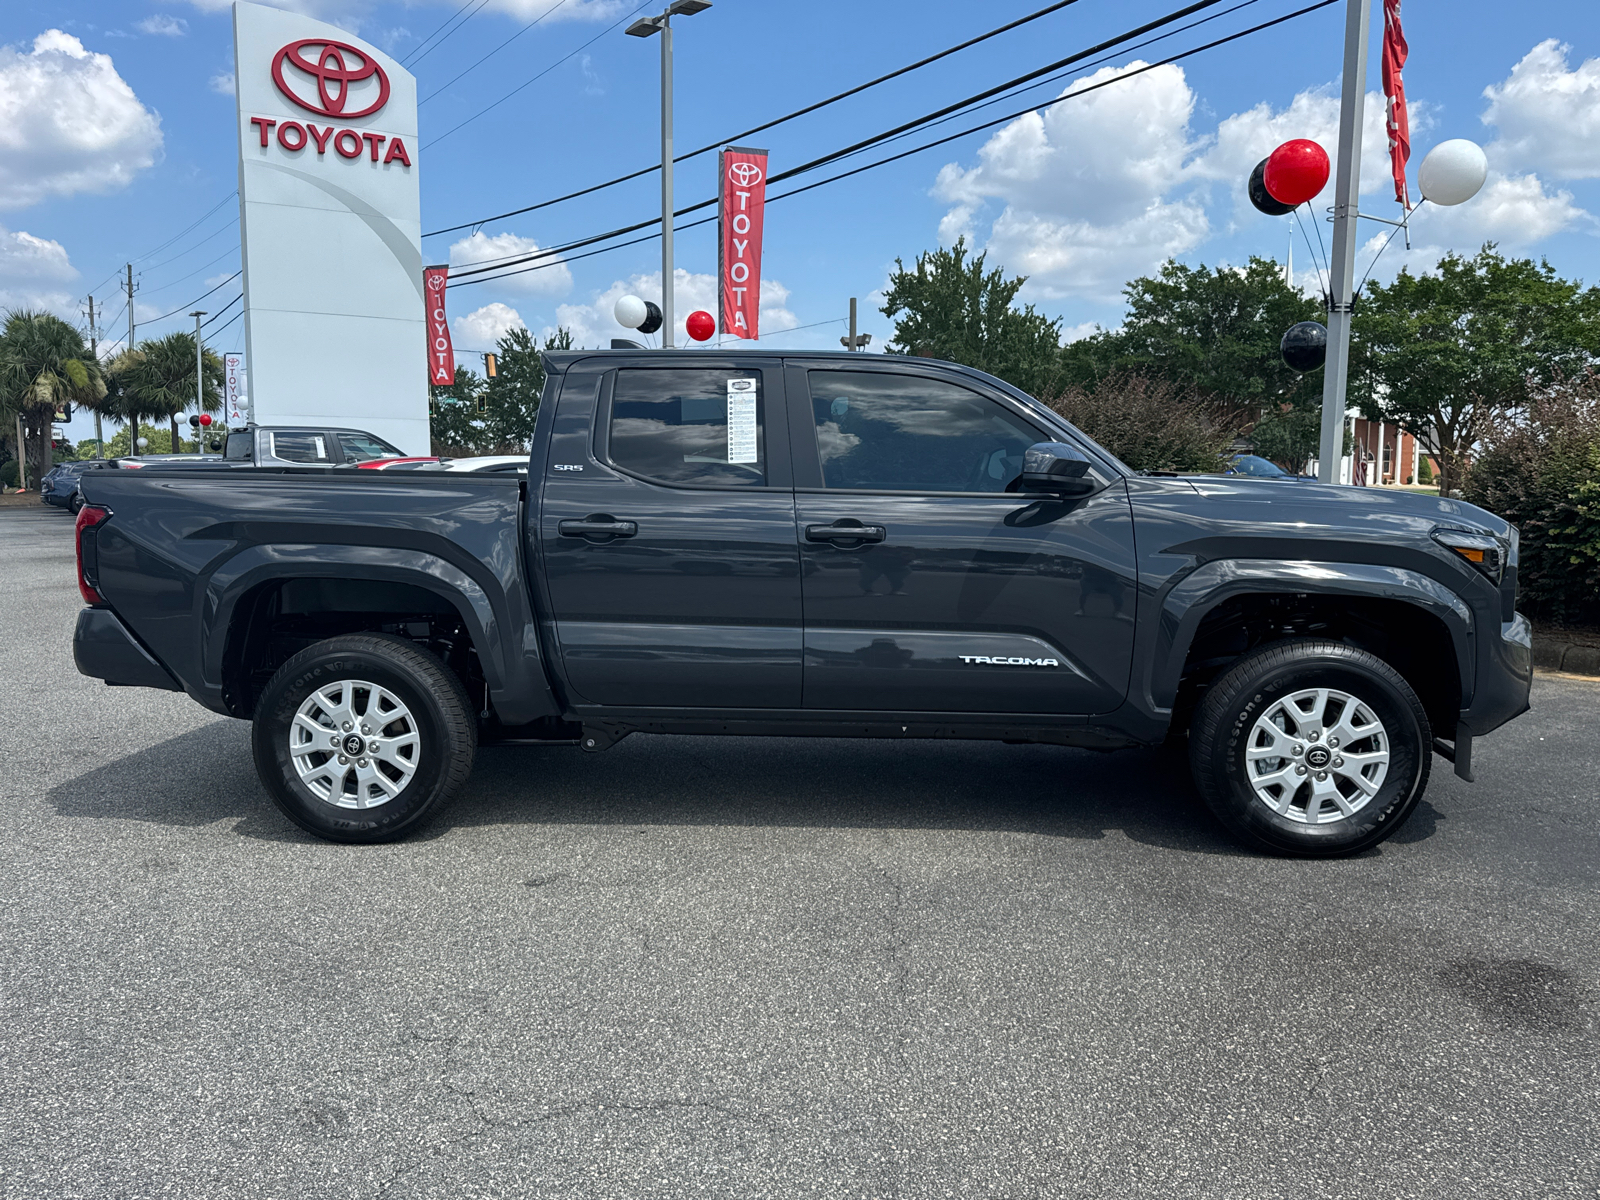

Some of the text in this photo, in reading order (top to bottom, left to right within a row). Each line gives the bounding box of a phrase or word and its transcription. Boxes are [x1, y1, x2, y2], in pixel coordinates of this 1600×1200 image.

[251, 117, 411, 167] TOYOTA
[730, 191, 751, 330] TOYOTA
[433, 294, 449, 380] TOYOTA
[228, 368, 241, 419] TOYOTA
[553, 464, 584, 472] SR5
[958, 655, 1059, 667] TACOMA
